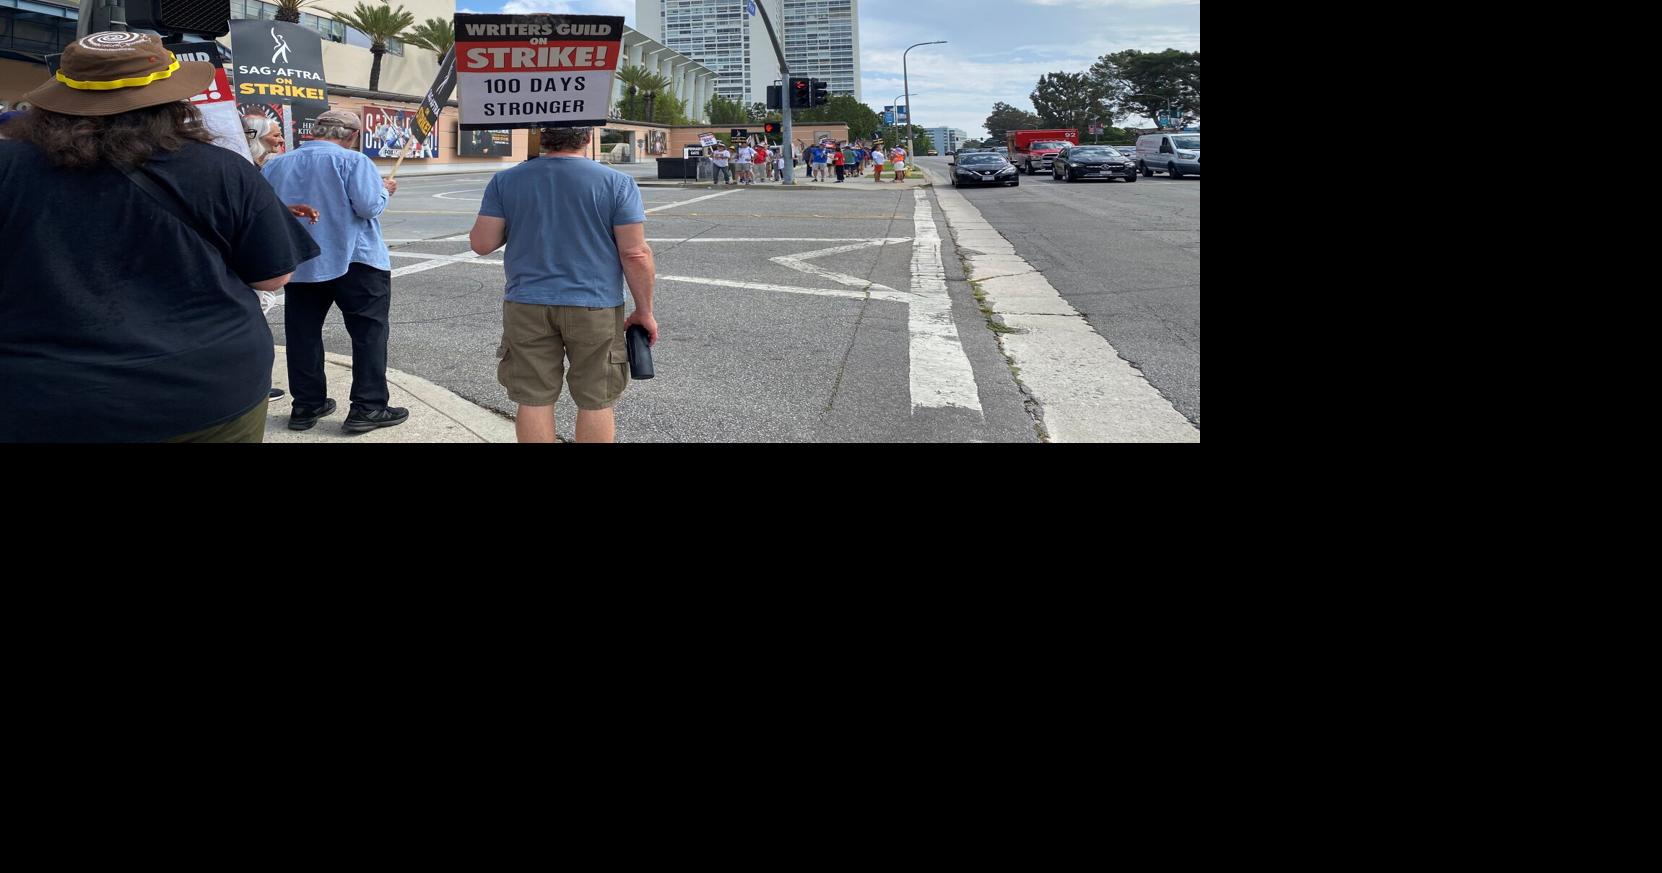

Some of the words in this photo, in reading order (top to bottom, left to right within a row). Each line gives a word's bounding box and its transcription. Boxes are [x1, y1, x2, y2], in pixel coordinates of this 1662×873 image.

[465, 23, 553, 36] WRITERS
[555, 23, 612, 36] GUILD
[529, 37, 548, 45] ON
[466, 46, 608, 69] STRIKE!
[275, 77, 293, 85] ON
[484, 78, 521, 94] 100
[530, 76, 586, 92] DAYS
[239, 82, 325, 100] STRIKE!
[483, 99, 585, 117] STRONGER
